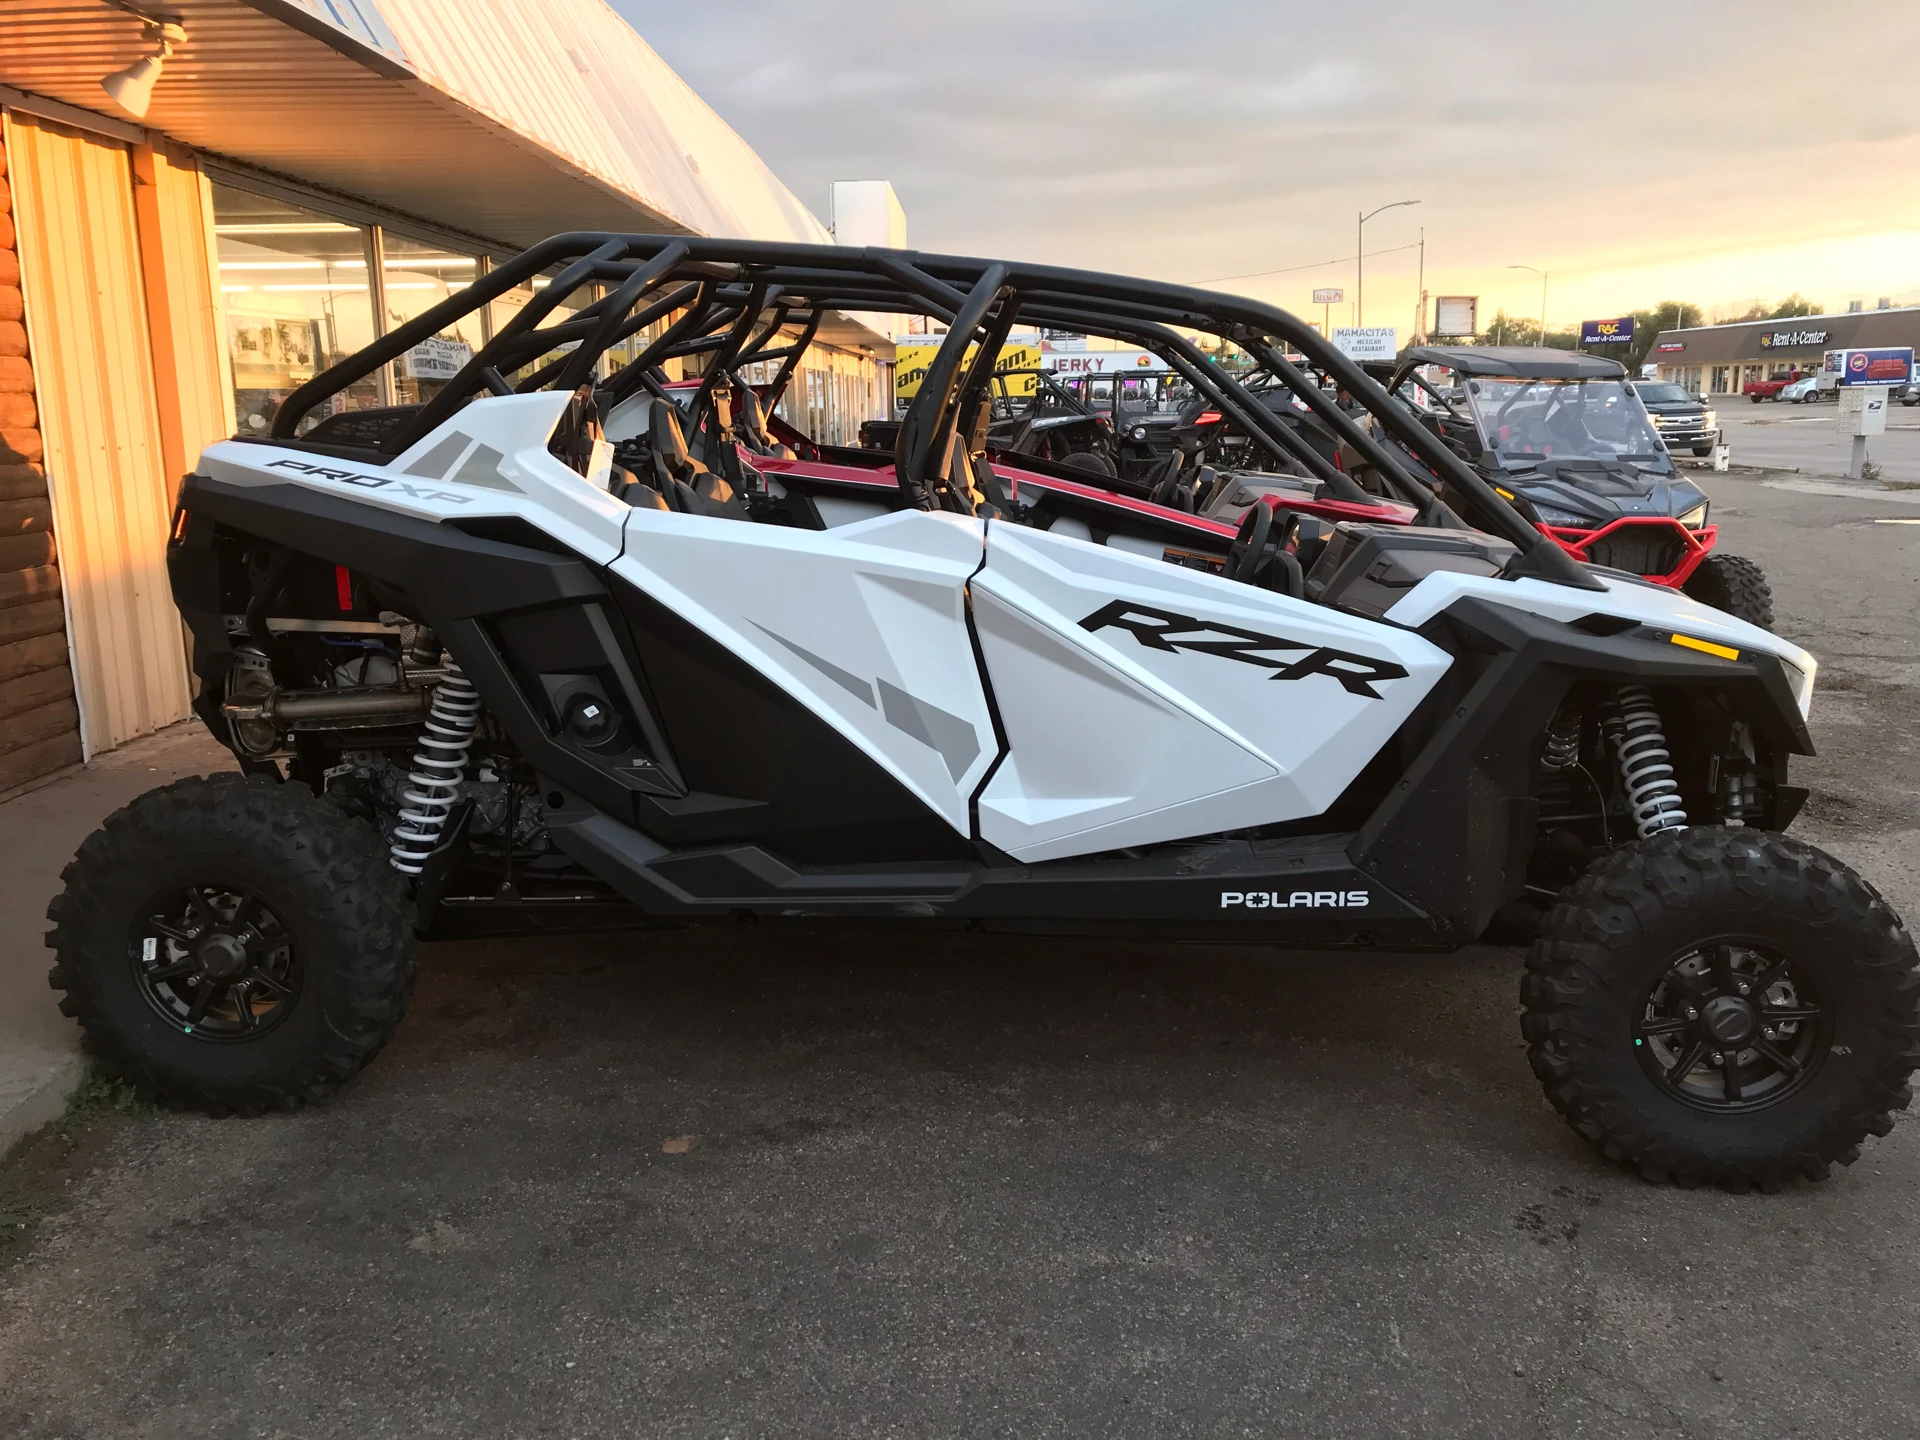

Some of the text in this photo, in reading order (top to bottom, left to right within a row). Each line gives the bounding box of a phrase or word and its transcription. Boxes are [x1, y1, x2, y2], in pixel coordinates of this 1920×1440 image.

[1336, 328, 1395, 337] MAMACITA'S
[1598, 323, 1619, 335] RAC
[264, 459, 394, 489] PRO
[1077, 599, 1410, 700] RZR
[1221, 891, 1369, 908] POLARIS
